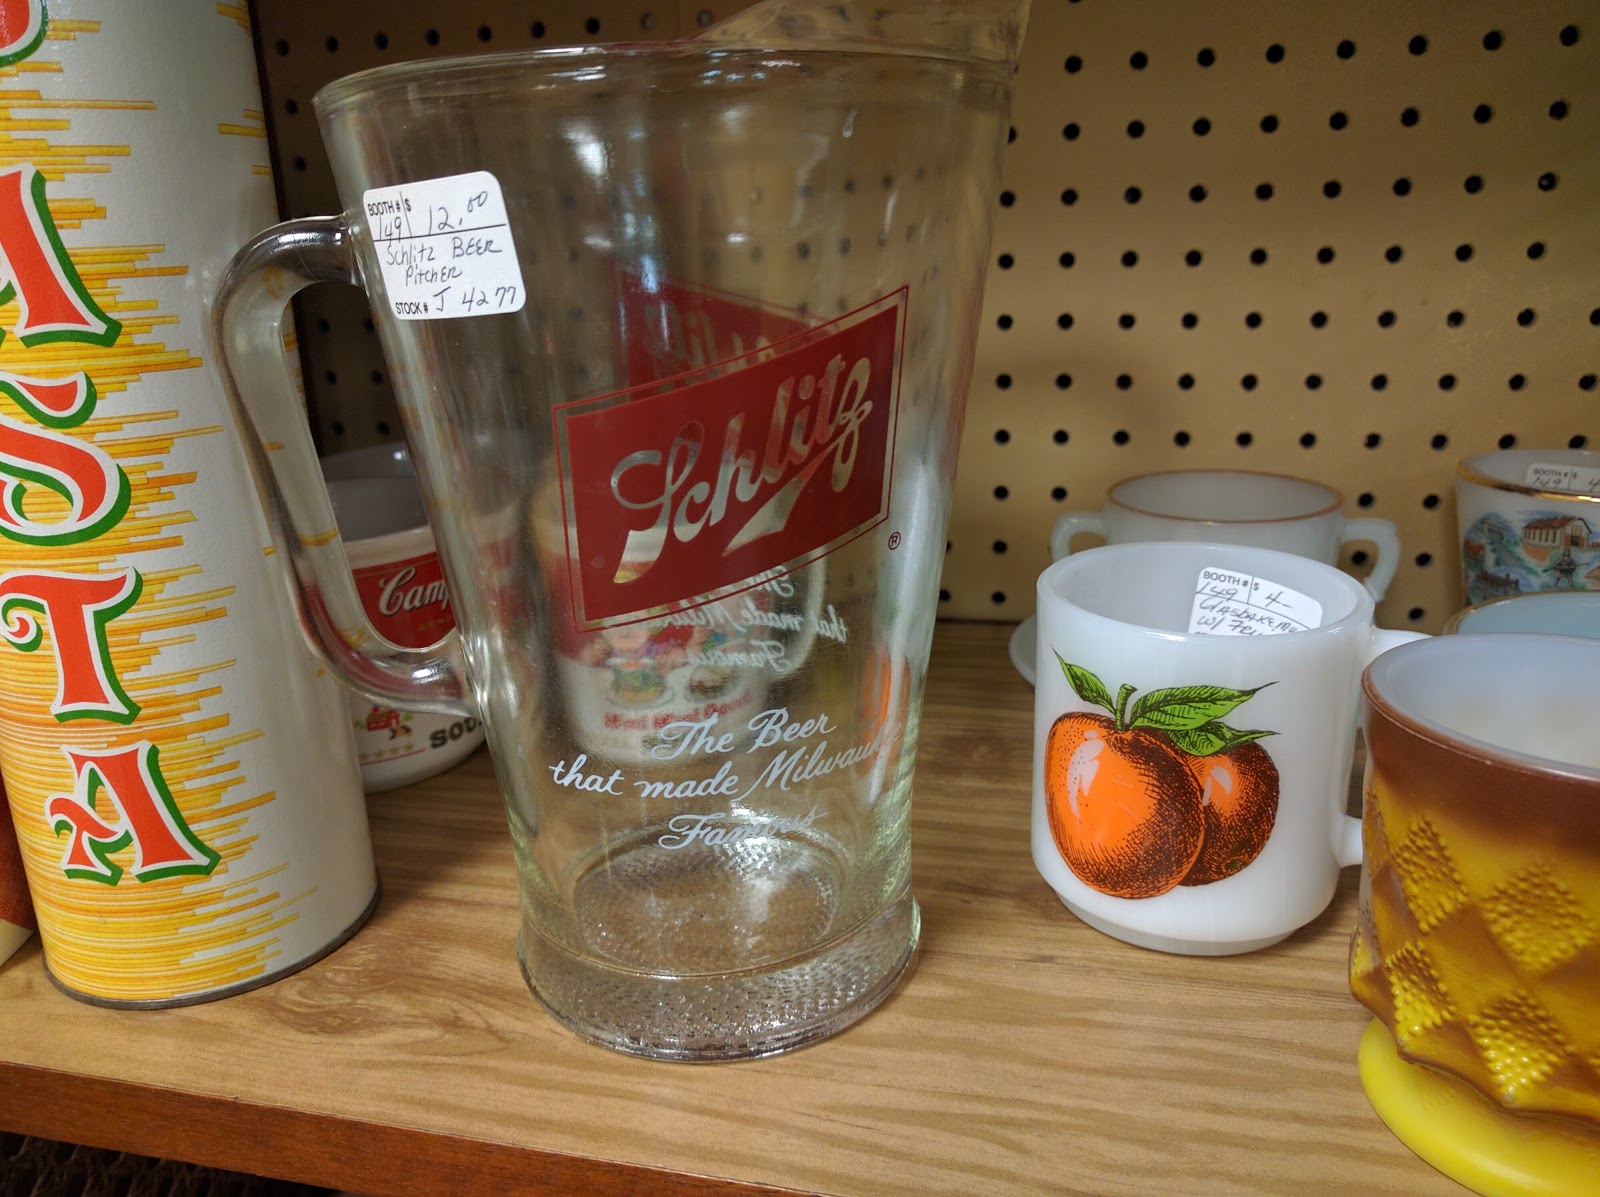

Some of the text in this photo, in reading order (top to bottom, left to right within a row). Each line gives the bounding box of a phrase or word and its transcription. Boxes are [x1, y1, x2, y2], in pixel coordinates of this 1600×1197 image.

[367, 200, 394, 216] BOOTH
[404, 198, 412, 212] $
[379, 216, 402, 243] 149
[386, 243, 436, 266] Schlitz
[395, 302, 422, 315] STOCK
[0, 0, 220, 882] ASTA
[611, 353, 873, 584] Schlitz
[1203, 571, 1240, 586] BOOTH
[1253, 582, 1259, 592] $
[1196, 581, 1238, 602] 149
[651, 712, 734, 760] The
[747, 707, 837, 754] Beer
[549, 754, 624, 796] that
[634, 761, 739, 799] made
[658, 804, 829, 850] Famous
